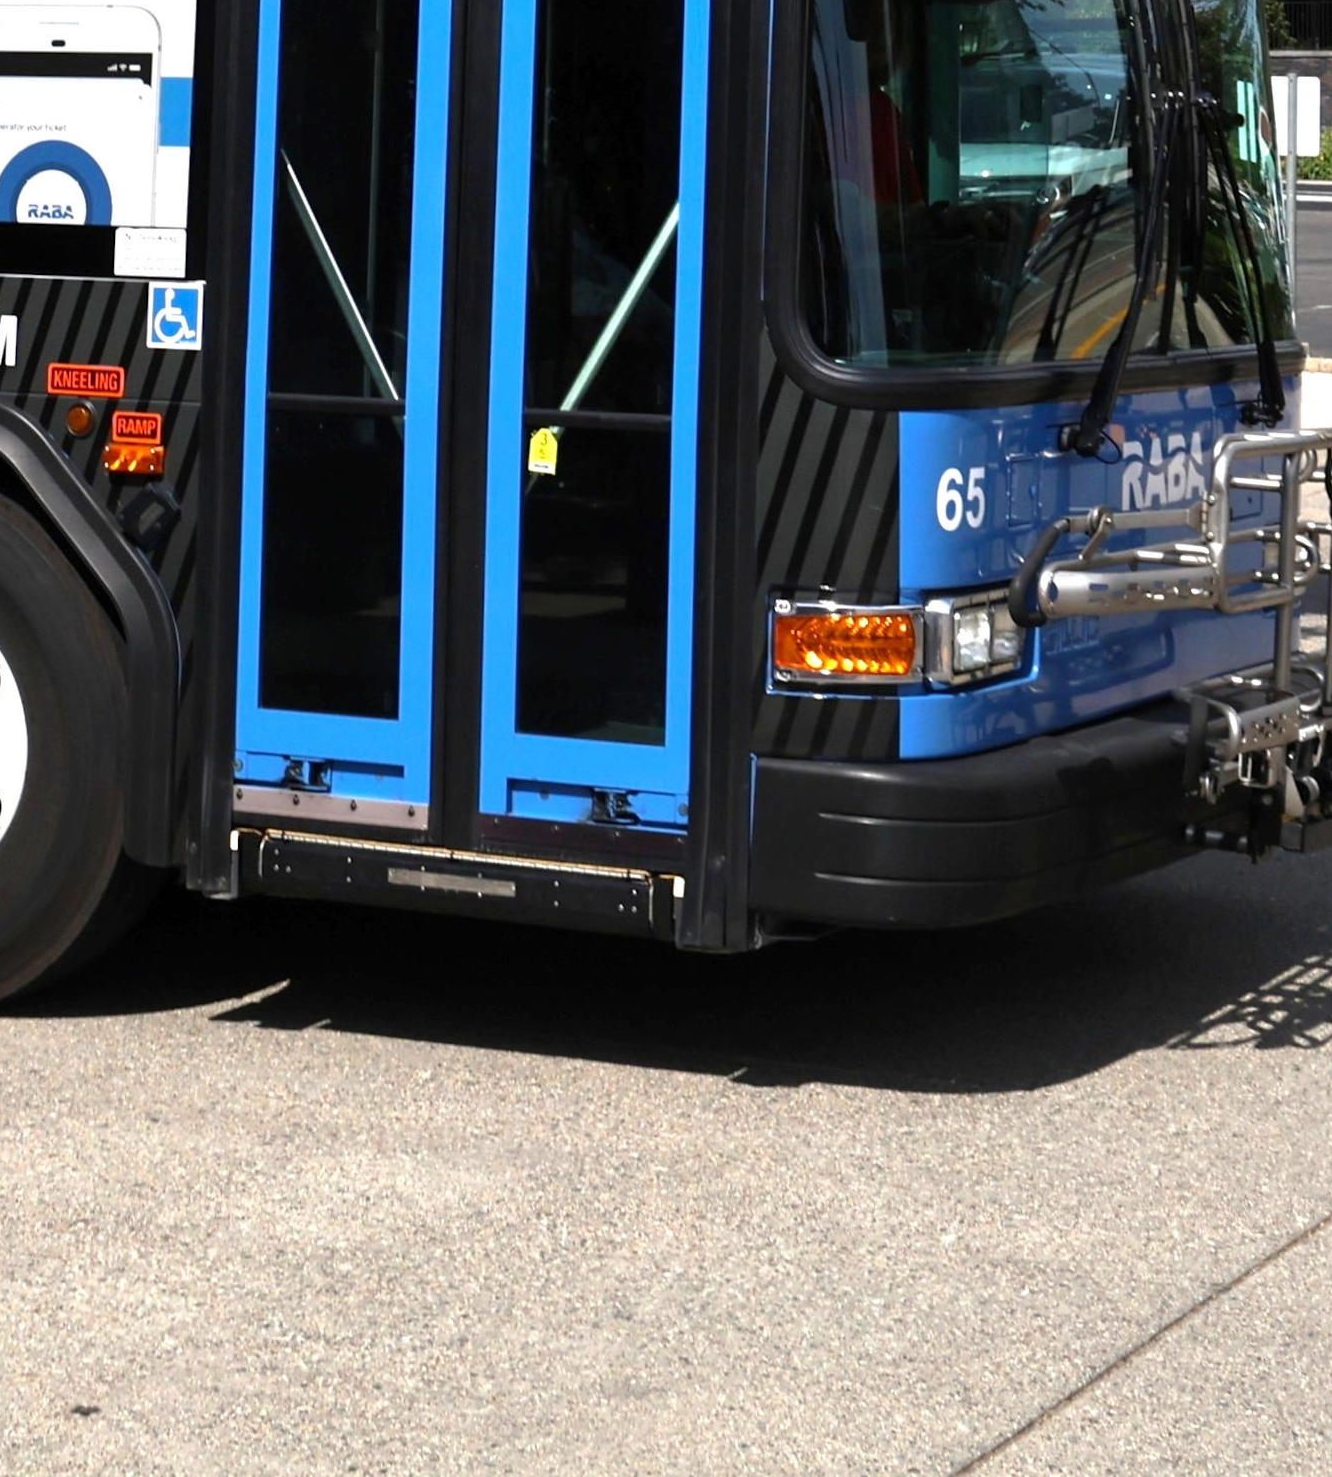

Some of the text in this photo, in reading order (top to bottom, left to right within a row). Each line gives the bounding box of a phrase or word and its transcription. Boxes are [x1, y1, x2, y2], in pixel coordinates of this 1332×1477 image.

[27, 203, 75, 220] RABA
[54, 370, 119, 391] KNEELING
[117, 417, 156, 436] RAMP
[1121, 430, 1208, 512] RABA
[936, 466, 986, 532] 65
